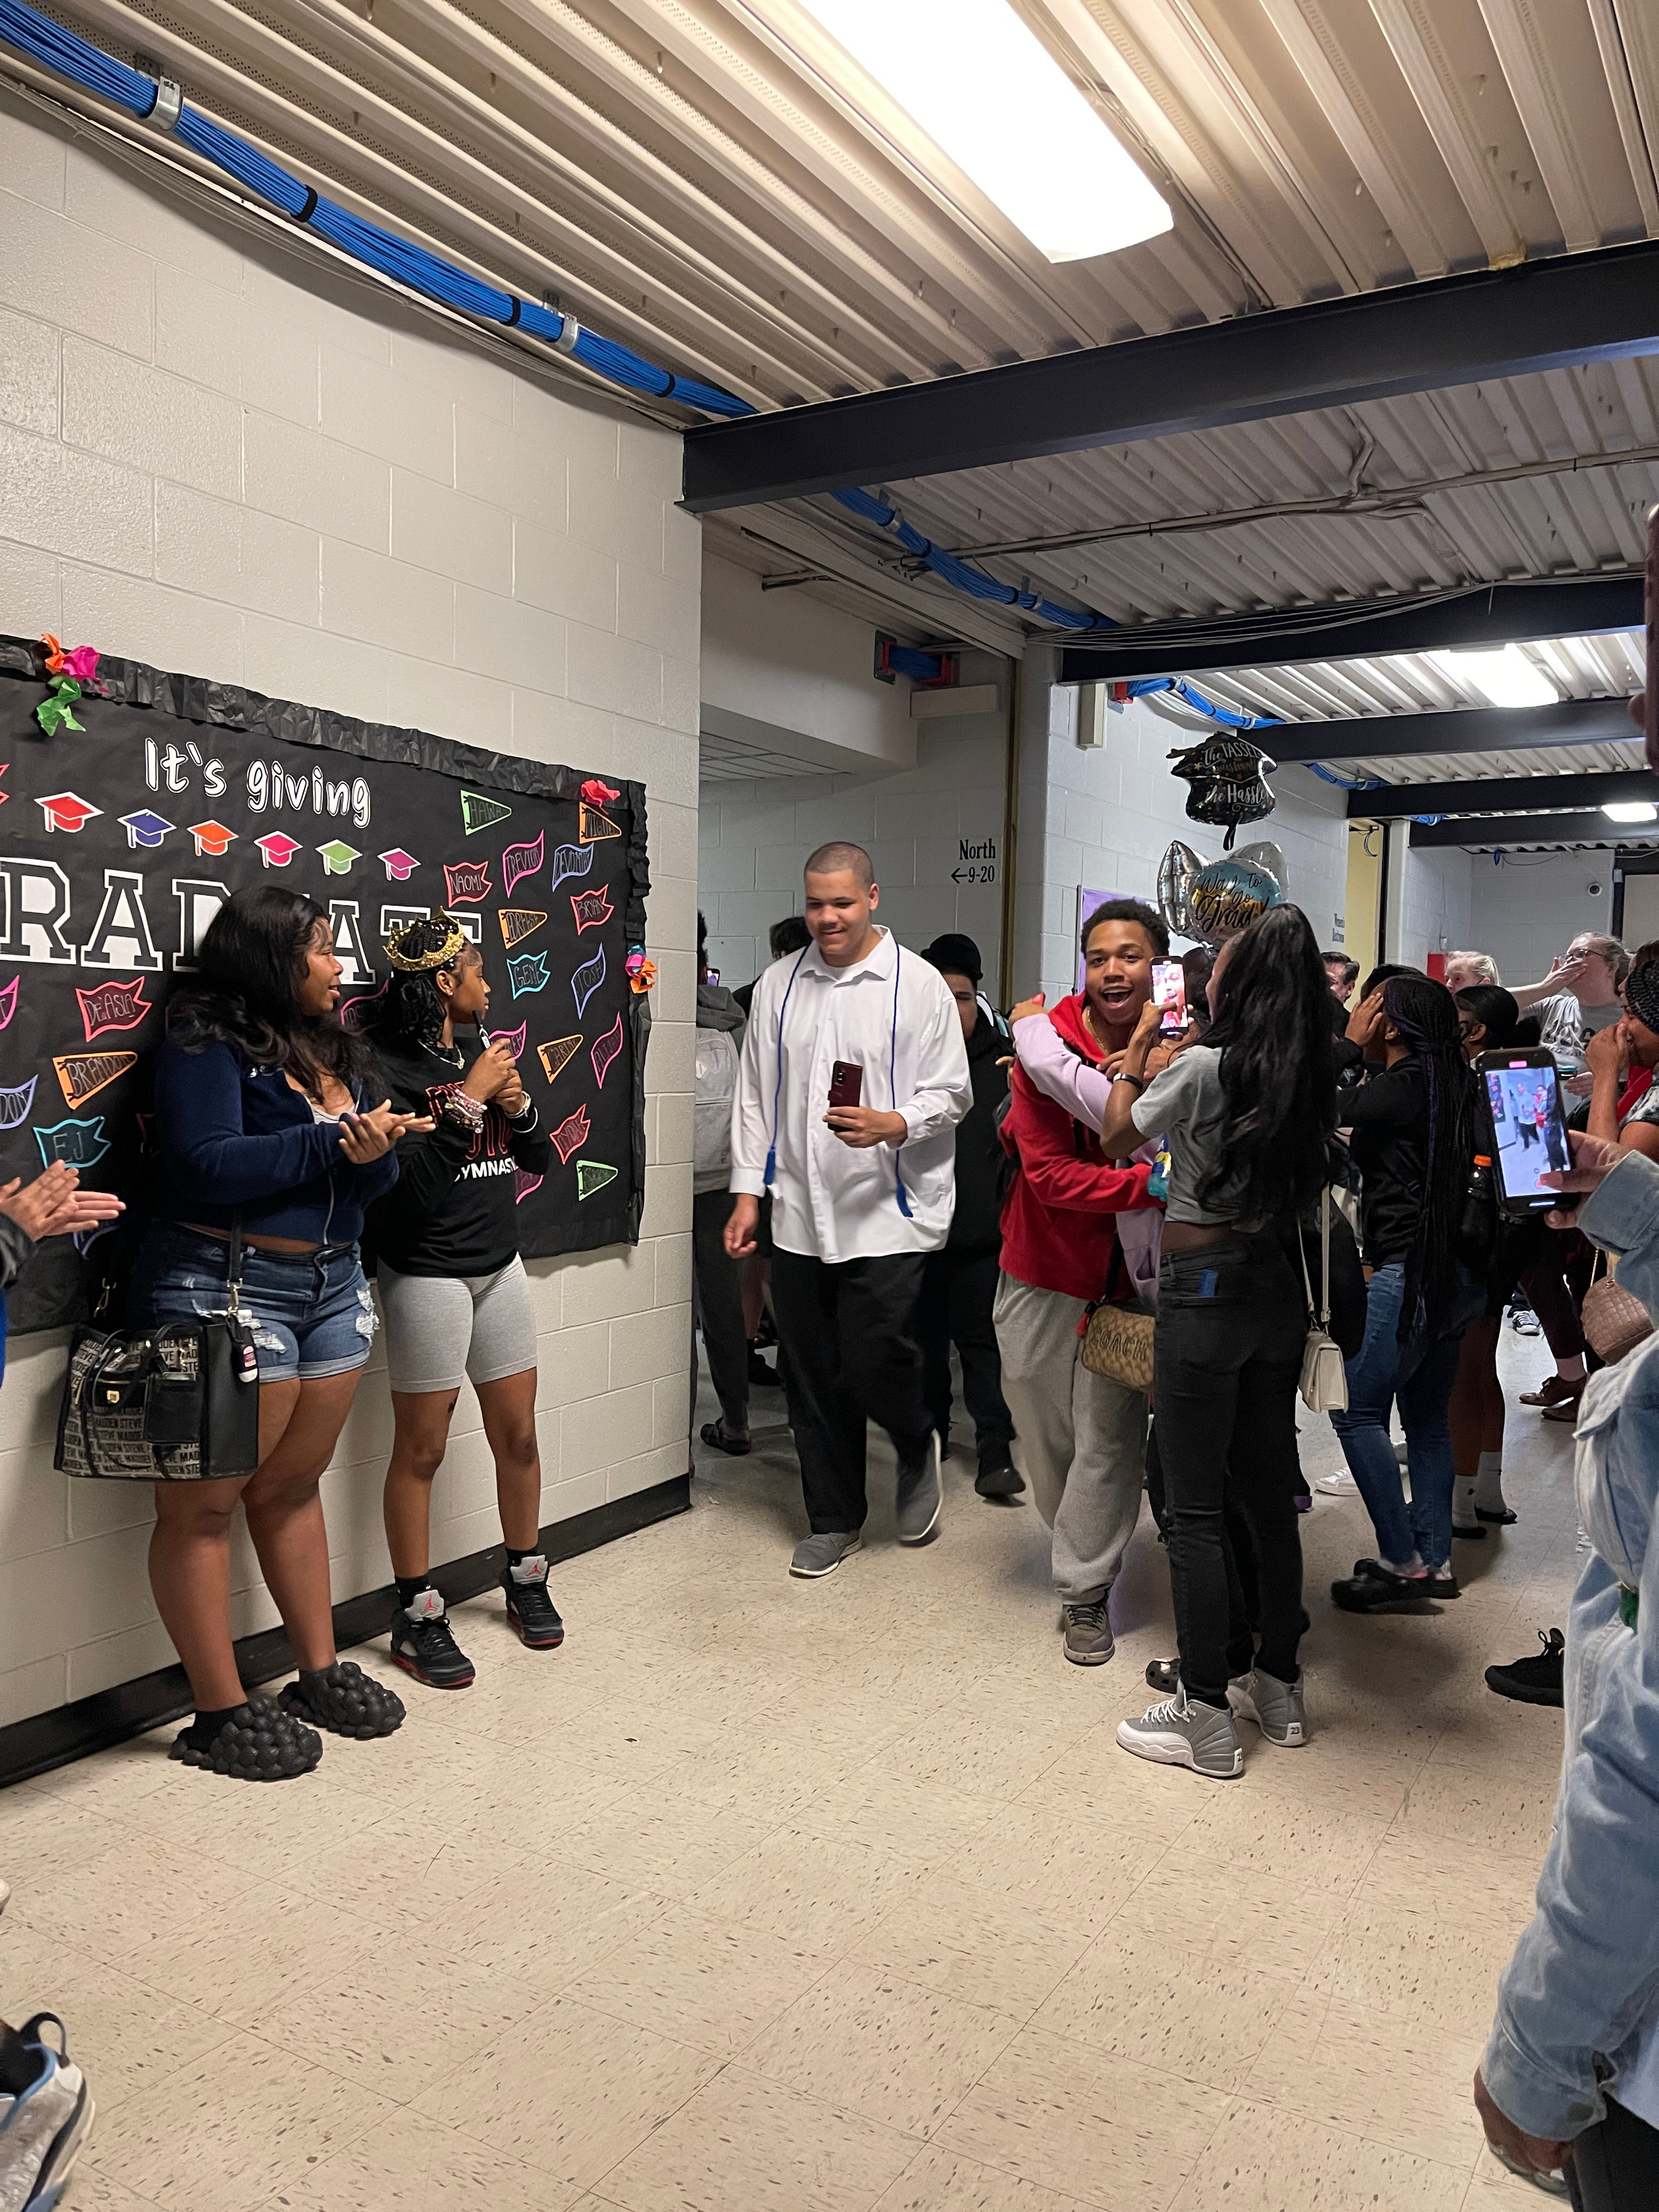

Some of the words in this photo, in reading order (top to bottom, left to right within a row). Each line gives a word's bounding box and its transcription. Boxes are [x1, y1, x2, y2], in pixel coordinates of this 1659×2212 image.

[1202, 747, 1223, 765] The
[144, 737, 227, 797] It's
[246, 759, 370, 828] giving
[1204, 785, 1226, 803] the
[469, 800, 502, 826] HAWA
[959, 838, 996, 860] North
[449, 872, 482, 895] NAOMI
[968, 865, 995, 883] 9-20
[1201, 873, 1240, 895] Way
[575, 897, 605, 922] BRYAN
[514, 960, 543, 988] GENE
[575, 961, 603, 999] JOSH
[52, 1131, 84, 1163] EJ
[1090, 1329, 1148, 1361] COACH
[1290, 1726, 1300, 1735] 23
